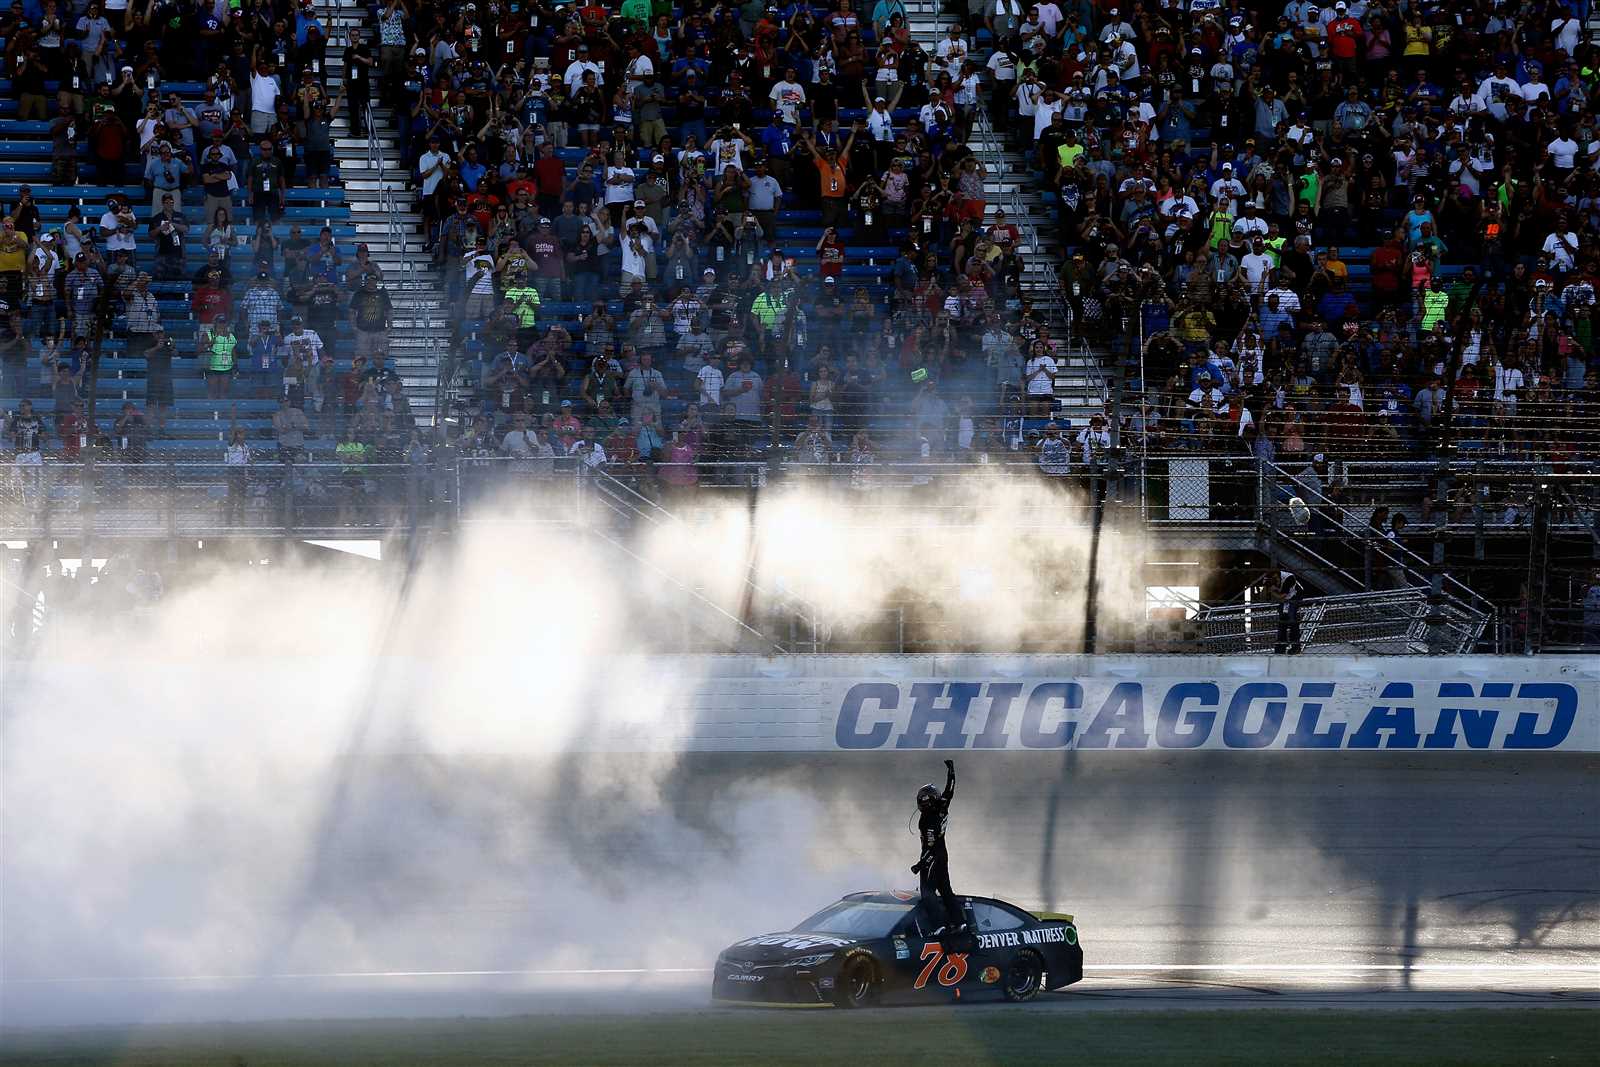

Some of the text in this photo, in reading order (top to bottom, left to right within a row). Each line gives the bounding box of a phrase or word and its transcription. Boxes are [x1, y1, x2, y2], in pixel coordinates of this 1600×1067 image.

[511, 258, 525, 267] 20
[835, 682, 1578, 750] CHICAGOLAND
[977, 927, 1065, 949] DENVER MATTRESS
[914, 942, 969, 989] 78
[727, 974, 764, 982] CAMRY
